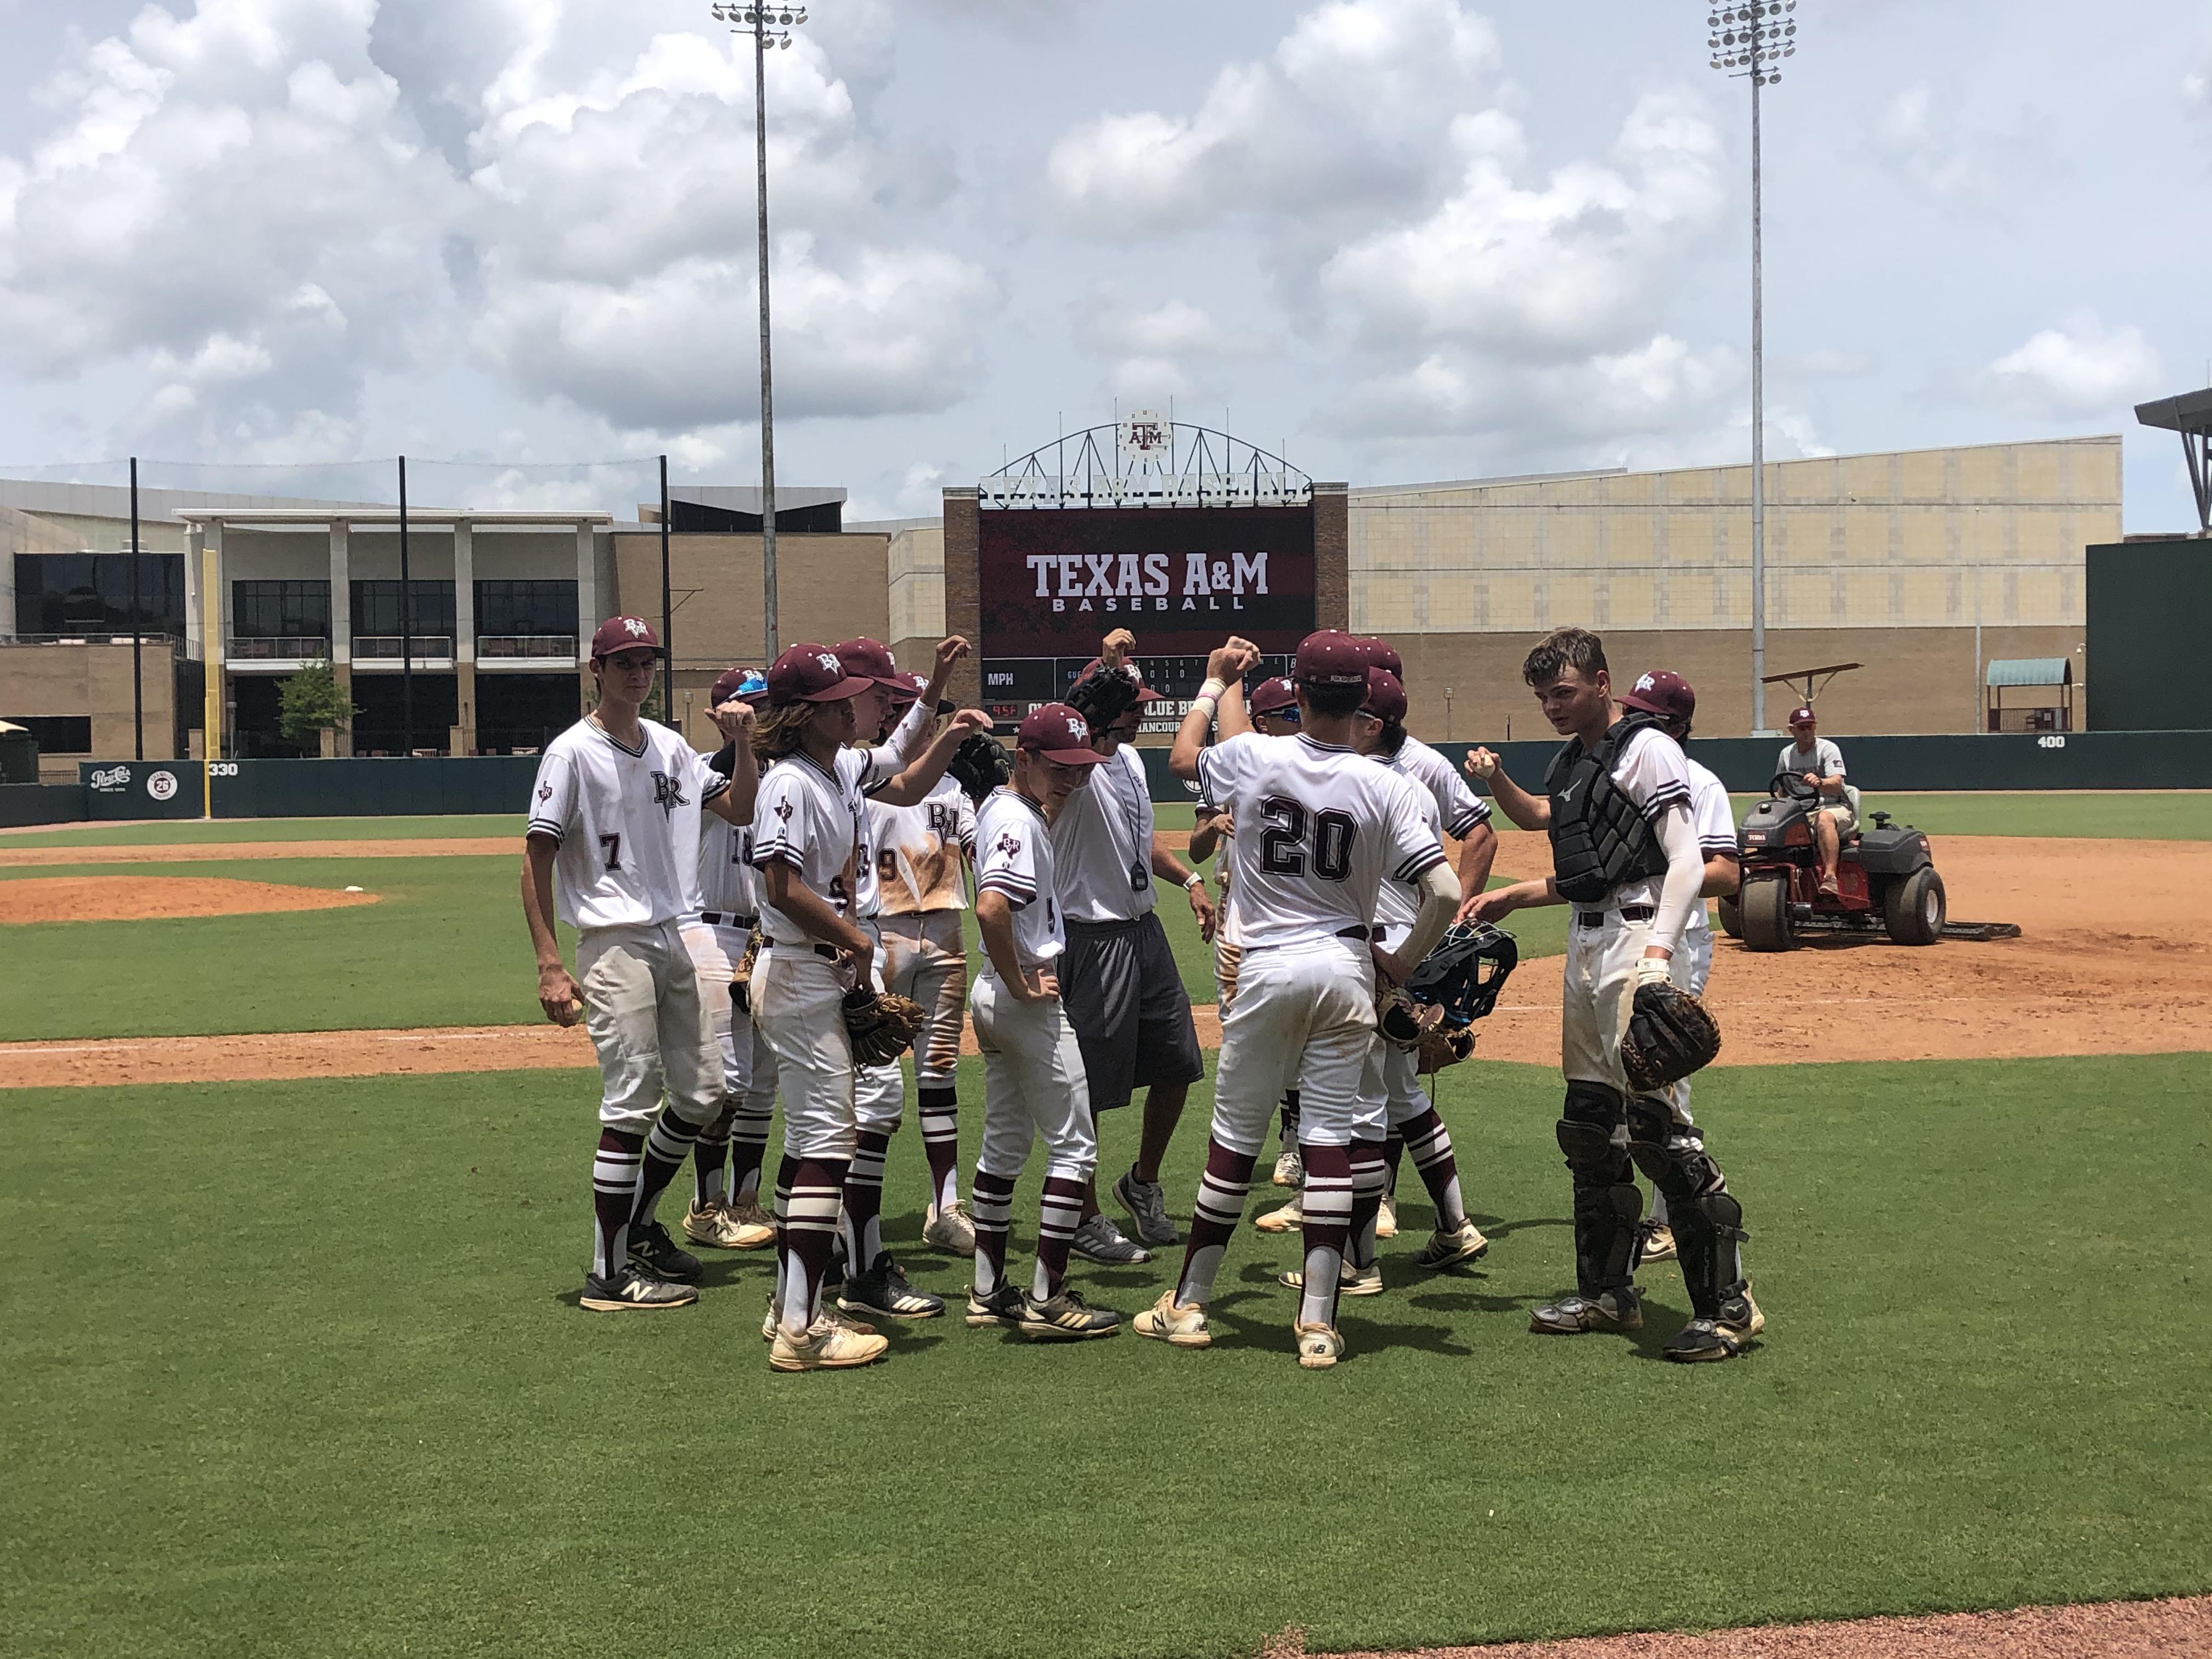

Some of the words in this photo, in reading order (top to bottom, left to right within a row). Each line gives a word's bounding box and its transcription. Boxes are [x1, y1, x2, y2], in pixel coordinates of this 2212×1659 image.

[980, 475, 1081, 505] TEXAS
[1093, 474, 1150, 504] A&M
[1161, 472, 1312, 501] BASEBALL
[1027, 554, 1169, 596] TEXAS
[1183, 552, 1268, 595] A&M
[1053, 597, 1244, 612] BASEBALL
[988, 673, 1014, 685] MPH
[1150, 670, 1155, 678] 0
[1165, 669, 1169, 678] 1
[1180, 669, 1184, 678] 0
[1165, 684, 1170, 692] 0
[1144, 701, 1175, 715] LUE
[2038, 736, 2065, 747] 400
[209, 763, 238, 776] 330
[156, 780, 169, 791] 26
[1260, 794, 1358, 883] 20
[600, 832, 621, 871] 7
[620, 1280, 653, 1302] N
